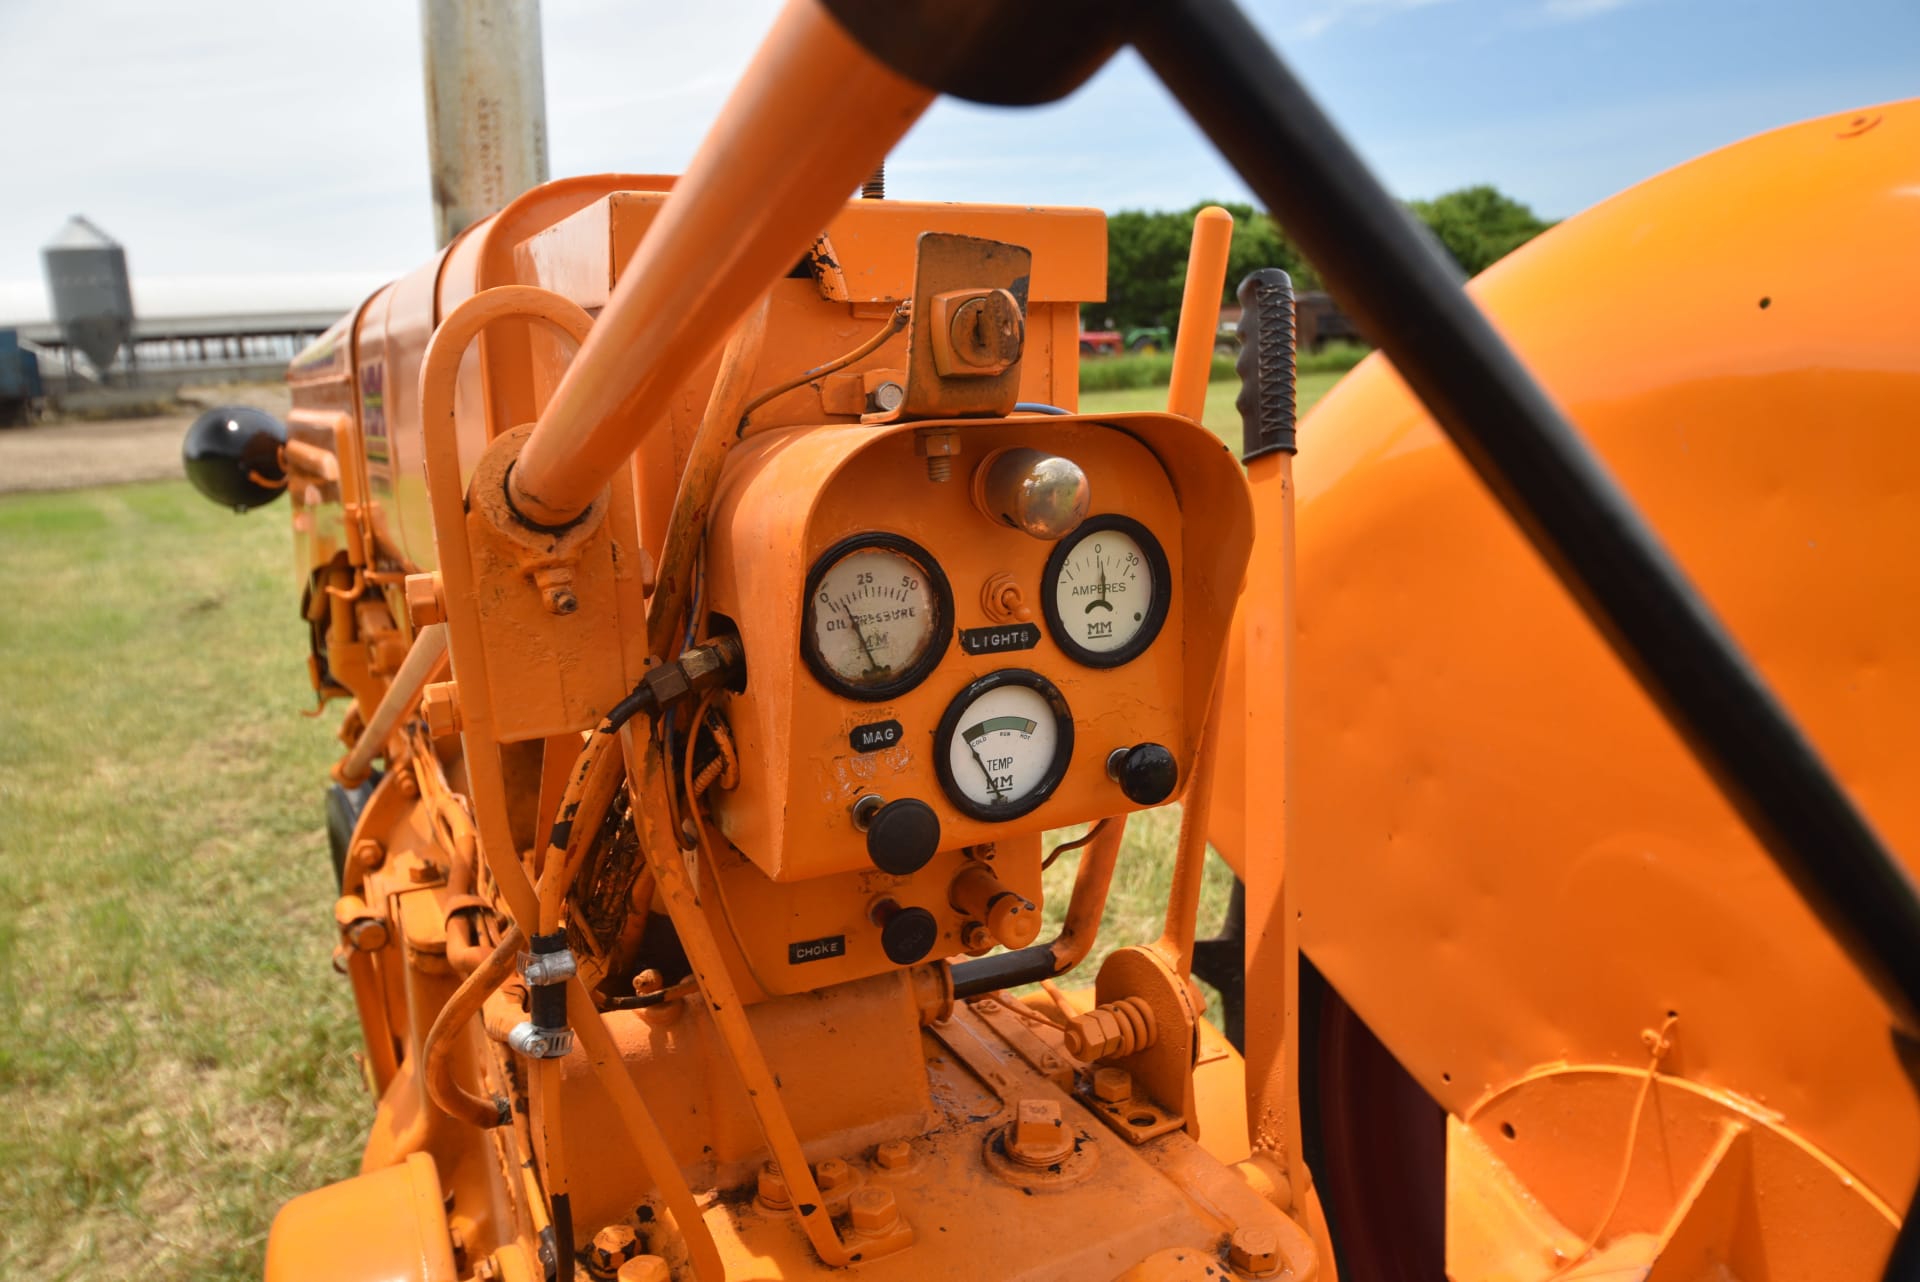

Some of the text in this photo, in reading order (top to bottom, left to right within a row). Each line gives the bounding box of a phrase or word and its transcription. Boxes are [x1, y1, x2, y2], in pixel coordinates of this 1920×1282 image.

[1095, 544, 1101, 553] 0
[1126, 552, 1139, 566] 30
[857, 573, 873, 585] 25
[902, 576, 918, 590] 50
[1072, 582, 1126, 596] AMPERES
[820, 592, 829, 603] 0
[826, 619, 847, 631] OIL
[1087, 621, 1113, 635] MM
[972, 631, 1029, 648] LIGHTS
[863, 728, 894, 744] MAG
[987, 757, 1013, 771] TEMP
[797, 942, 839, 958] CHOKE
